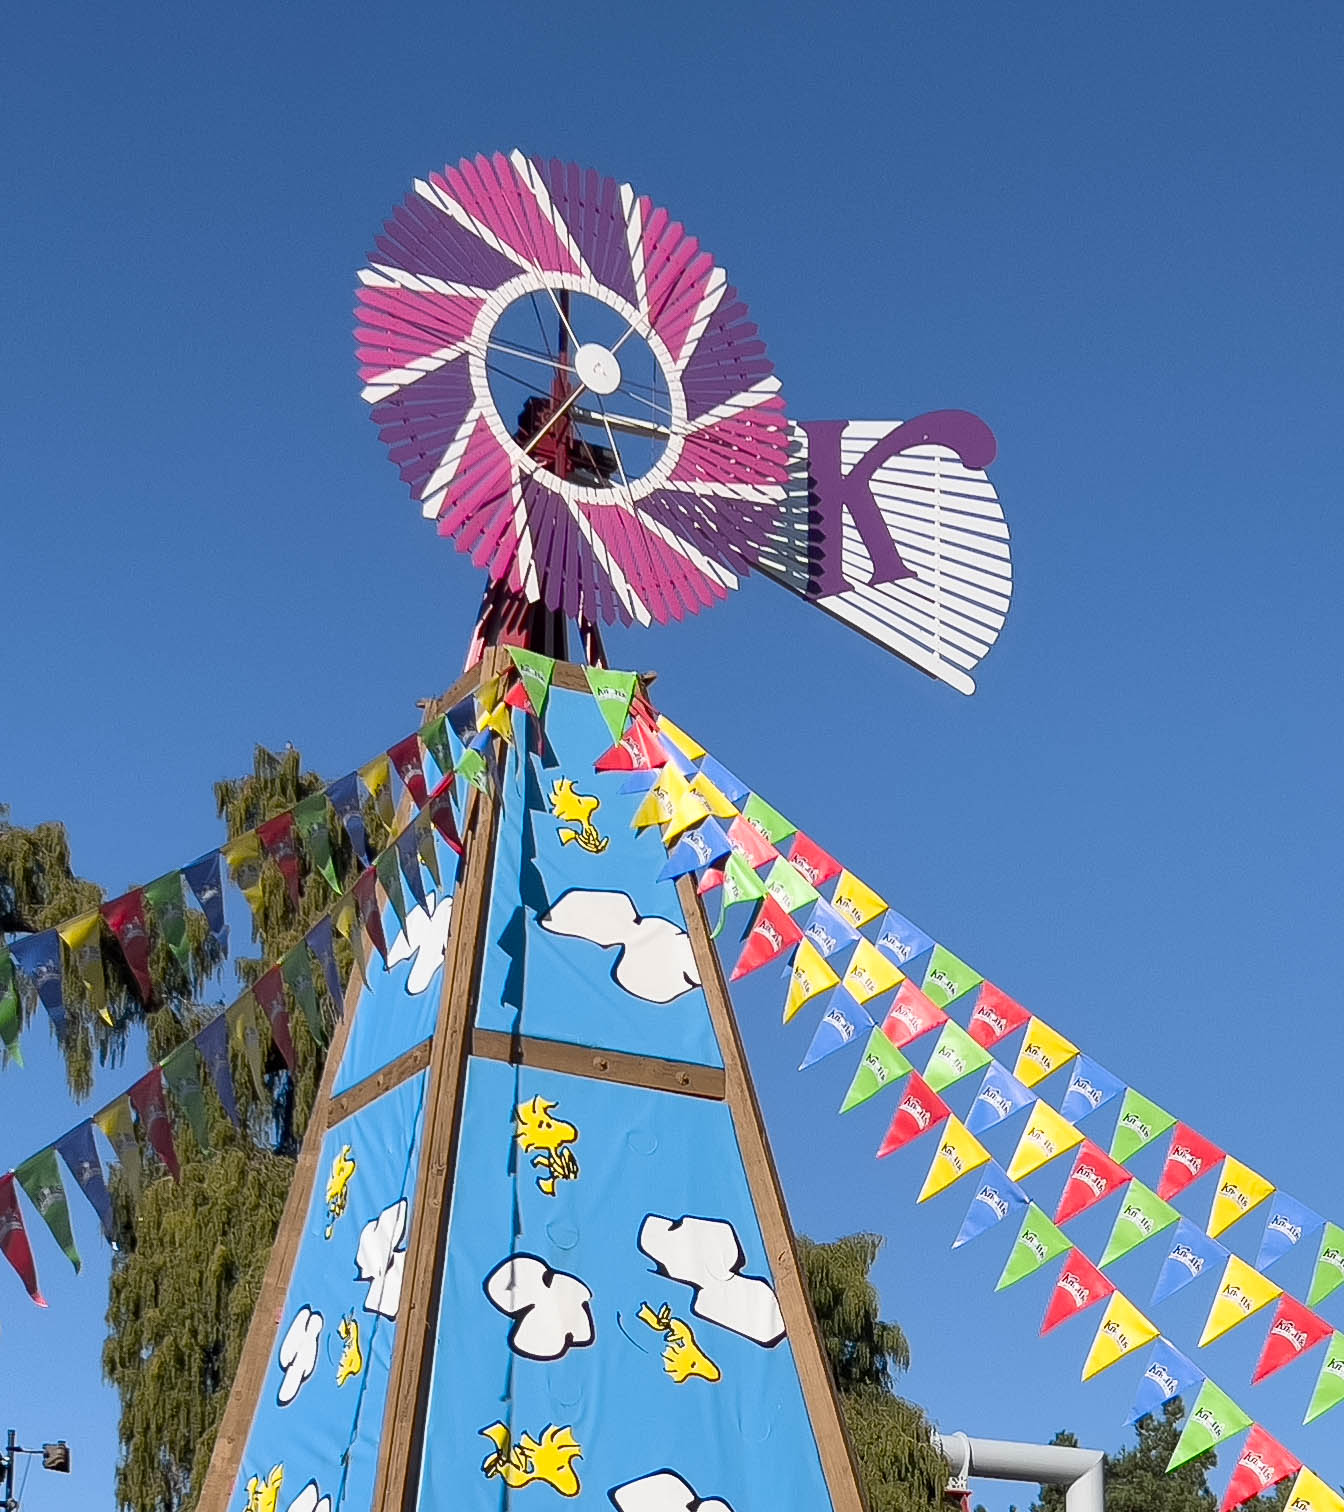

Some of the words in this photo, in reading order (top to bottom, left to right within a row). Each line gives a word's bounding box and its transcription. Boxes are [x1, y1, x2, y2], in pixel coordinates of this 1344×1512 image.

[797, 409, 998, 601] K
[597, 687, 626, 698] Kntt's
[687, 832, 710, 856] Kntt's
[791, 855, 818, 881] Kntt's
[769, 880, 794, 906] Kntt's
[835, 897, 861, 922] Kntt's
[760, 920, 783, 951] Kntt's
[808, 923, 835, 951] Kntt's
[883, 932, 910, 959] Kntt's
[794, 966, 812, 993] Kntt's
[851, 966, 874, 992] Kntt's
[930, 969, 956, 997] Kntt's
[828, 1009, 853, 1038] Kntt's
[895, 1005, 918, 1031] Kntt's
[978, 1007, 1004, 1033] Kntt's
[865, 1052, 887, 1081] Kntt's
[938, 1046, 964, 1072] Kntt's
[1025, 1045, 1050, 1069] Kntt's
[983, 1088, 1008, 1113] Kntt's
[1074, 1078, 1099, 1102] Kntt's
[904, 1097, 930, 1126] Kntt's
[1123, 1113, 1151, 1138] Kntt's
[1029, 1129, 1054, 1154] Kntt's
[942, 1144, 962, 1171] Kntt's
[1173, 1146, 1200, 1171] Kntt's
[1077, 1166, 1103, 1193] Kntt's
[980, 1186, 1006, 1215] Kntt's
[1221, 1183, 1248, 1207] Kntt's
[1124, 1206, 1151, 1232] Kntt's
[1271, 1215, 1300, 1241] Kntt's
[1022, 1230, 1046, 1258] Kntt's
[1173, 1246, 1201, 1271] Kntt's
[1062, 1273, 1088, 1302] Kntt's
[1224, 1285, 1250, 1311] Kntt's
[1104, 1320, 1128, 1350] Kntt's
[1276, 1320, 1305, 1346] Kntt's
[1149, 1363, 1176, 1394] Kntt's
[1195, 1407, 1222, 1437] Kntt's
[1243, 1452, 1271, 1480] Kntt's
